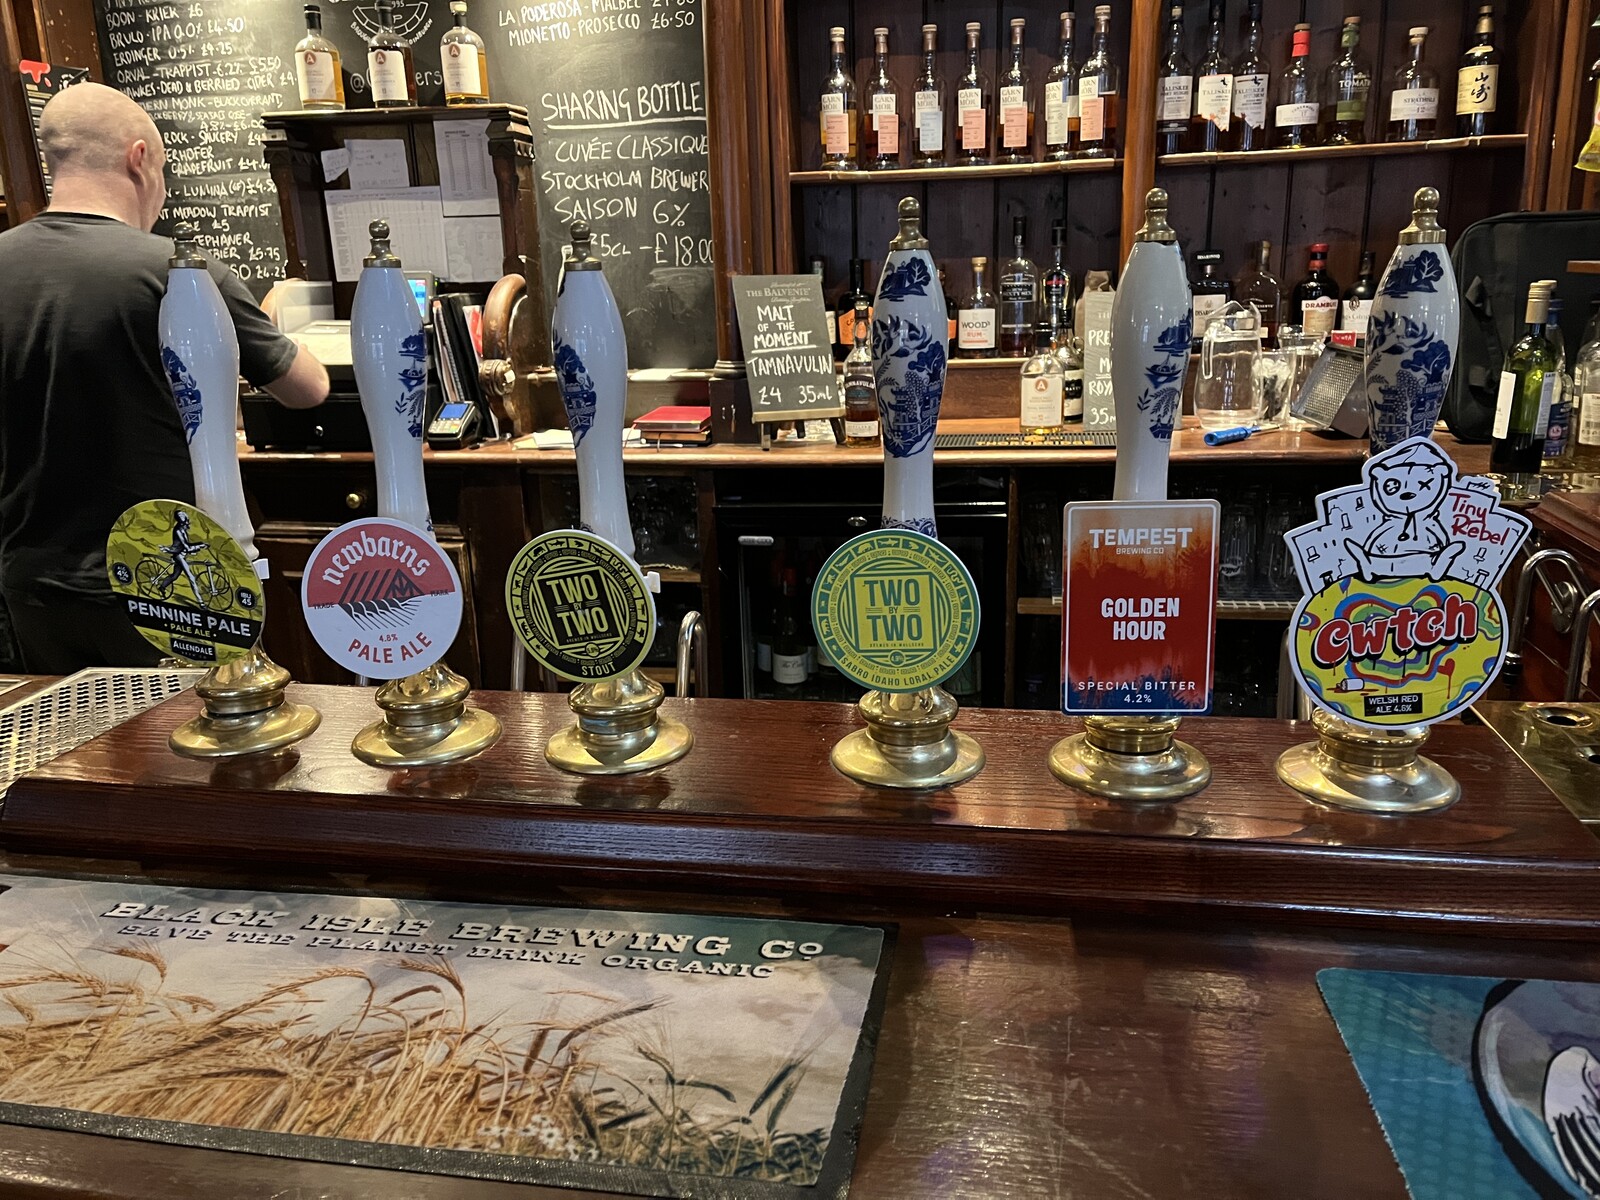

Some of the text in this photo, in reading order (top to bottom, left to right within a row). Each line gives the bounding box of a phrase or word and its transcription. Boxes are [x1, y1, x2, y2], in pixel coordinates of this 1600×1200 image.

[106, 12, 135, 31] BOON
[145, 6, 179, 23] KRIEK
[188, 3, 203, 19] £6
[499, 10, 516, 27] LA
[521, 3, 583, 25] PODEROSA
[152, 24, 172, 41] IPA
[509, 21, 571, 47] MIONETTO
[577, 13, 641, 38] PROSECCO
[113, 47, 161, 67] ERDINGER
[117, 67, 151, 84] ORVAL
[156, 62, 212, 79] TRAPPIST
[160, 80, 184, 95] DEAD
[194, 77, 240, 93] BERRIED
[247, 73, 274, 91] CIDER
[171, 95, 206, 111] MONK
[541, 87, 633, 122] SHARING
[163, 131, 189, 145] ROCK
[555, 136, 613, 163] CUVÉE
[171, 158, 234, 178] GRAPEFRUIT
[184, 182, 229, 199] LUMINA
[541, 168, 643, 194] STOCKHOLM
[220, 203, 273, 218] TRAPPIST
[554, 196, 638, 223] SAISON
[757, 305, 794, 322] MALT
[757, 321, 795, 333] OF THE
[753, 330, 813, 349] MOMENT
[746, 353, 833, 377] TAMNAVULIN
[758, 386, 782, 405] £4
[1448, 491, 1488, 524] Tiny
[1089, 527, 1194, 549] TEMPEST
[1450, 514, 1511, 546] Rebel
[322, 530, 431, 586] newbarns
[1116, 546, 1165, 555] BREWING CO
[546, 574, 599, 606] TWO
[863, 578, 921, 607] TWO
[573, 601, 583, 611] BY
[888, 606, 899, 615] BY
[1101, 597, 1180, 618] GOLDEN
[127, 599, 252, 637] PENNINE PALE
[556, 606, 609, 638] TWO
[866, 613, 923, 642] TWO
[170, 623, 211, 638] PALE ALE
[379, 633, 398, 643] 4.8%
[1113, 620, 1167, 641] HOUR
[173, 640, 214, 656] ALLENDALE
[348, 631, 433, 664] PALE ALE
[581, 661, 617, 677] STOUT
[840, 655, 956, 687] SABRO IDAHO LORAL PALE
[1078, 681, 1197, 691] SPECIAL BITTER
[1123, 693, 1153, 704] 4.2%
[1368, 694, 1419, 706] WELSH RED
[1375, 704, 1393, 714] ALE
[100, 902, 291, 929] BLACK
[299, 912, 436, 939] ISLE
[449, 921, 733, 960] BREWING
[117, 924, 777, 980] SAVE THE PLANET DRINK ORGANIC
